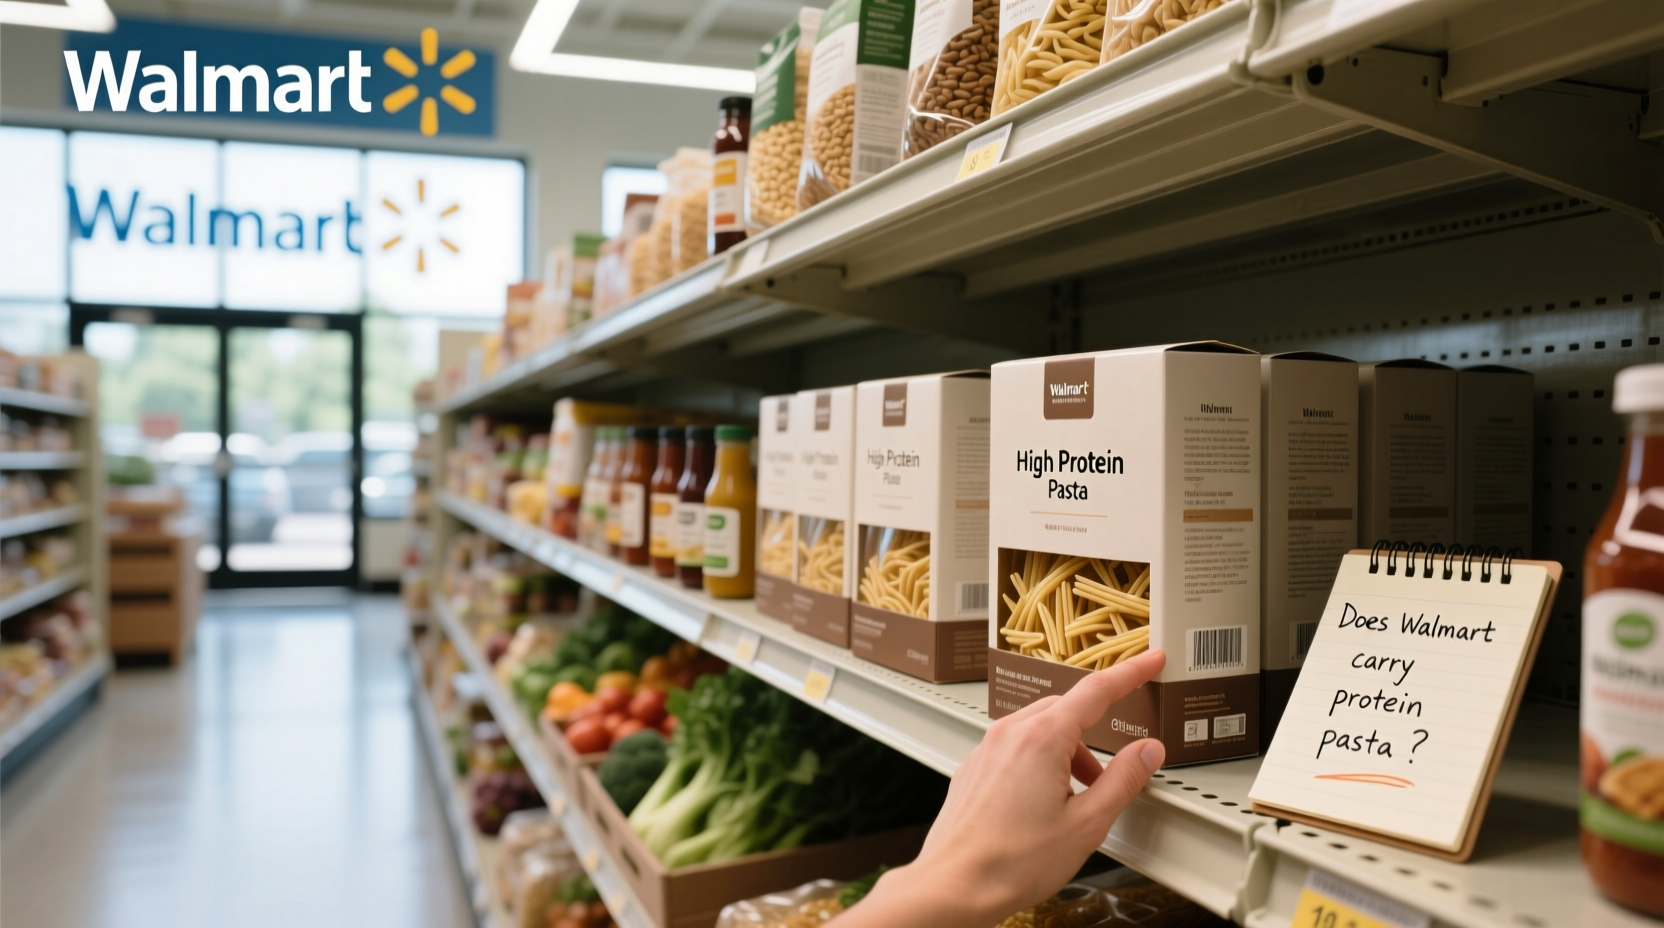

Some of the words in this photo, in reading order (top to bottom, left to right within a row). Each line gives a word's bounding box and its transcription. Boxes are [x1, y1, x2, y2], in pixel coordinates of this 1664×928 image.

[66, 183, 363, 255] Walmart
[1017, 449, 1054, 478] High
[1058, 449, 1124, 475] Protein
[1048, 479, 1088, 501] Pasta
[1338, 602, 1389, 632] Does
[1401, 612, 1496, 643] Walmart
[1351, 653, 1415, 687] carry
[1328, 688, 1422, 718] protein
[1316, 729, 1392, 760] pasta
[1409, 729, 1429, 764] ?
